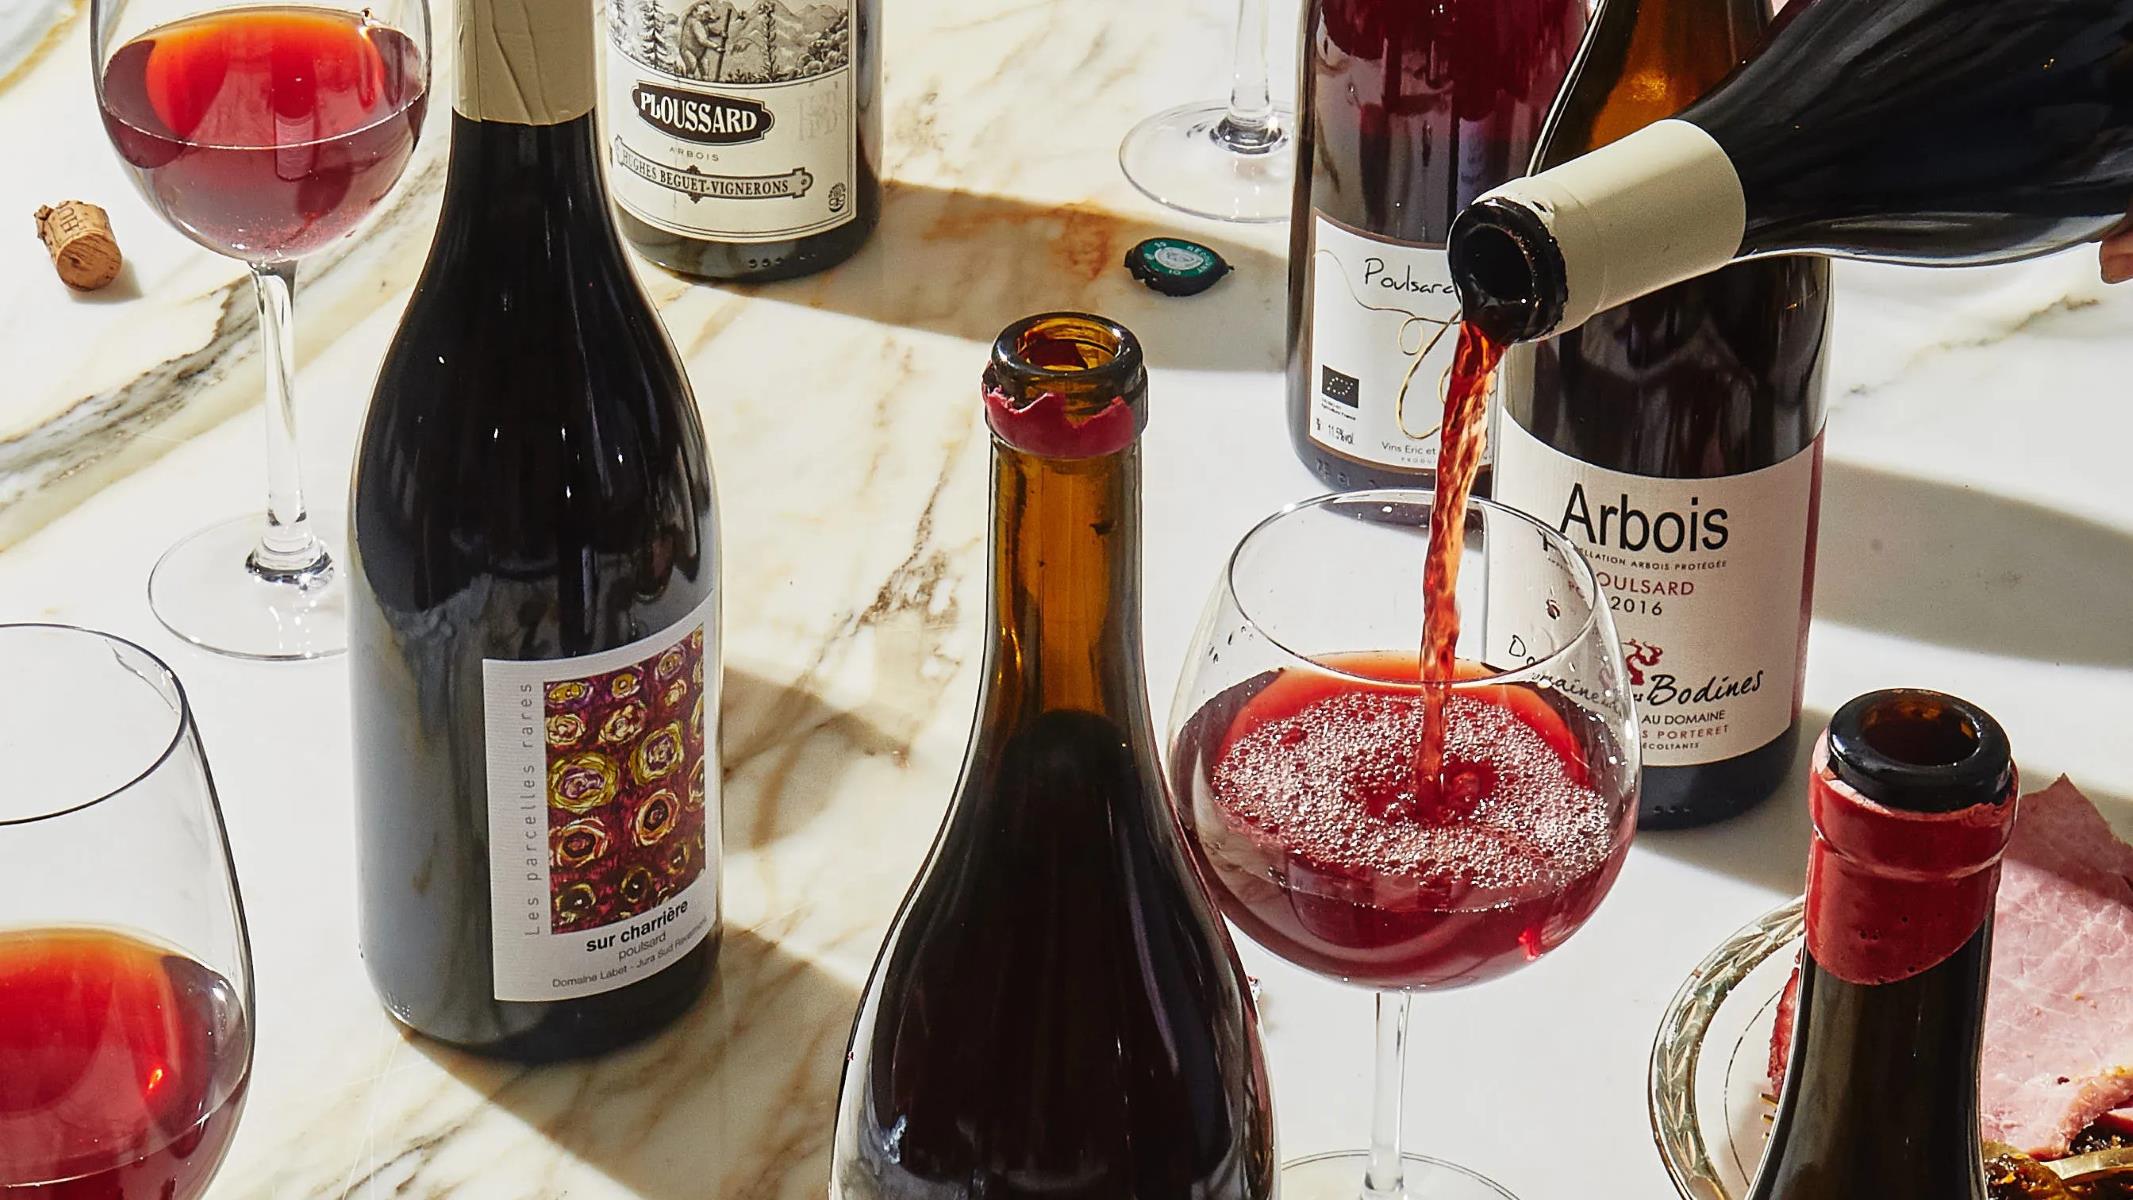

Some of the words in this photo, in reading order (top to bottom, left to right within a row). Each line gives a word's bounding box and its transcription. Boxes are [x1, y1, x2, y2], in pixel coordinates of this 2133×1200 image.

[640, 91, 757, 134] PLOUSSARD
[669, 147, 719, 161] ARBOIS
[622, 150, 657, 179] HUGHES
[660, 170, 788, 195] BEGUET-VIGNERONS
[1382, 441, 1401, 453] Vins
[1405, 446, 1423, 455] Eric
[1426, 447, 1436, 455] et
[1560, 482, 1729, 553] Arbois
[1631, 560, 1670, 571] ARBOIS
[1596, 571, 1694, 596] OULSARD
[1611, 595, 1662, 616] 2016
[1647, 671, 1763, 706] Bodines
[520, 683, 533, 748] rares
[1641, 714, 1661, 725] AU
[1664, 710, 1726, 725] DOMAINE
[1657, 724, 1729, 740] PORTERET
[520, 764, 542, 881] parcelles
[525, 897, 540, 935] Les
[586, 934, 617, 952] sur
[620, 901, 688, 943] charrière
[618, 932, 667, 961] poulsard
[552, 975, 598, 988] Domaine
[600, 964, 628, 980] Labet
[636, 954, 656, 969] Jura
